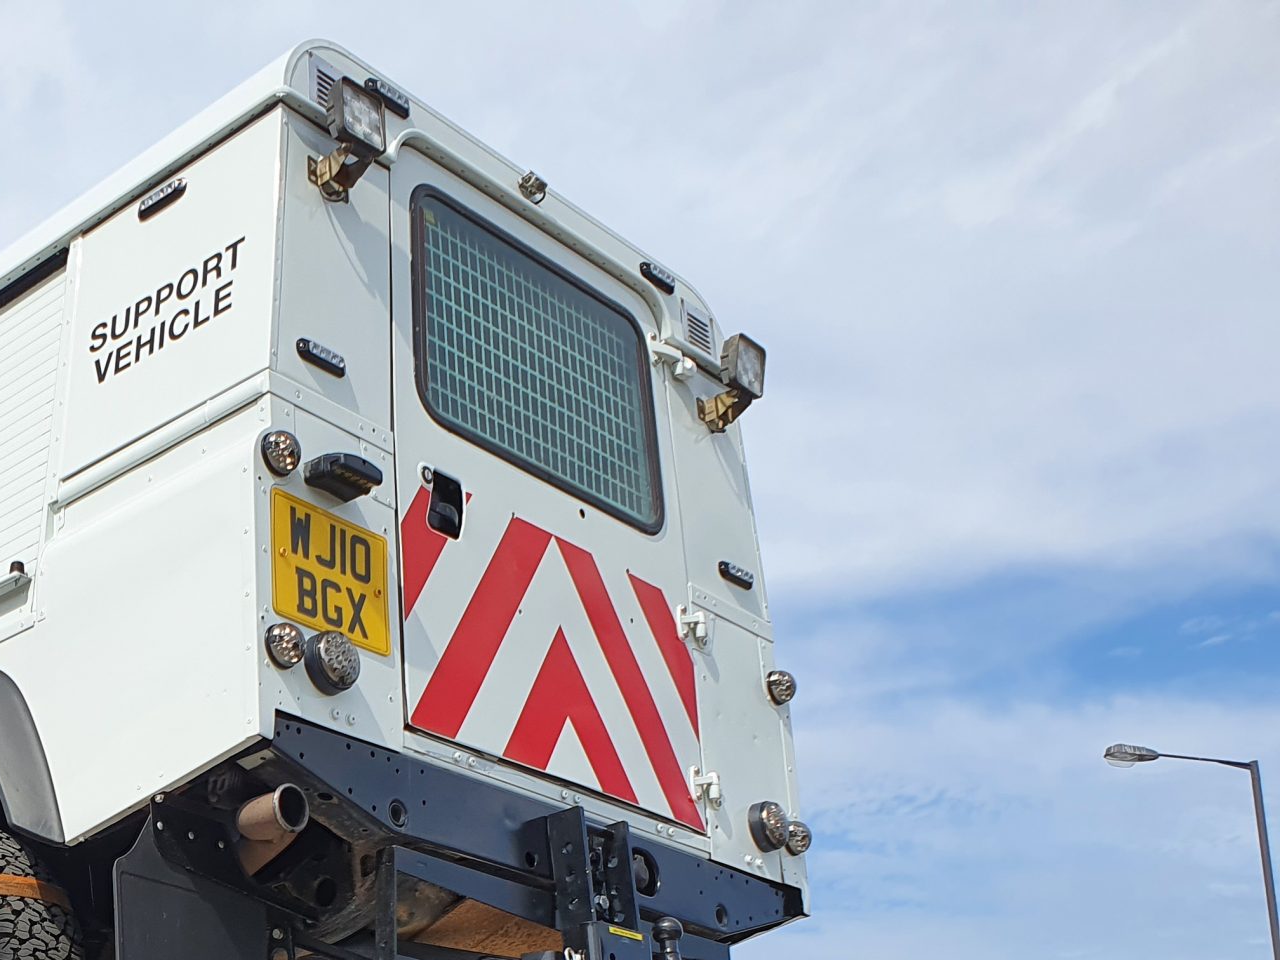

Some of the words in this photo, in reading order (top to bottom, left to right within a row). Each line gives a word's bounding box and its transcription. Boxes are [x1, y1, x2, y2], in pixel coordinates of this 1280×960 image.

[89, 235, 246, 353] SUPPORT
[94, 279, 234, 385] VEHICLE
[295, 565, 369, 640] BGX
